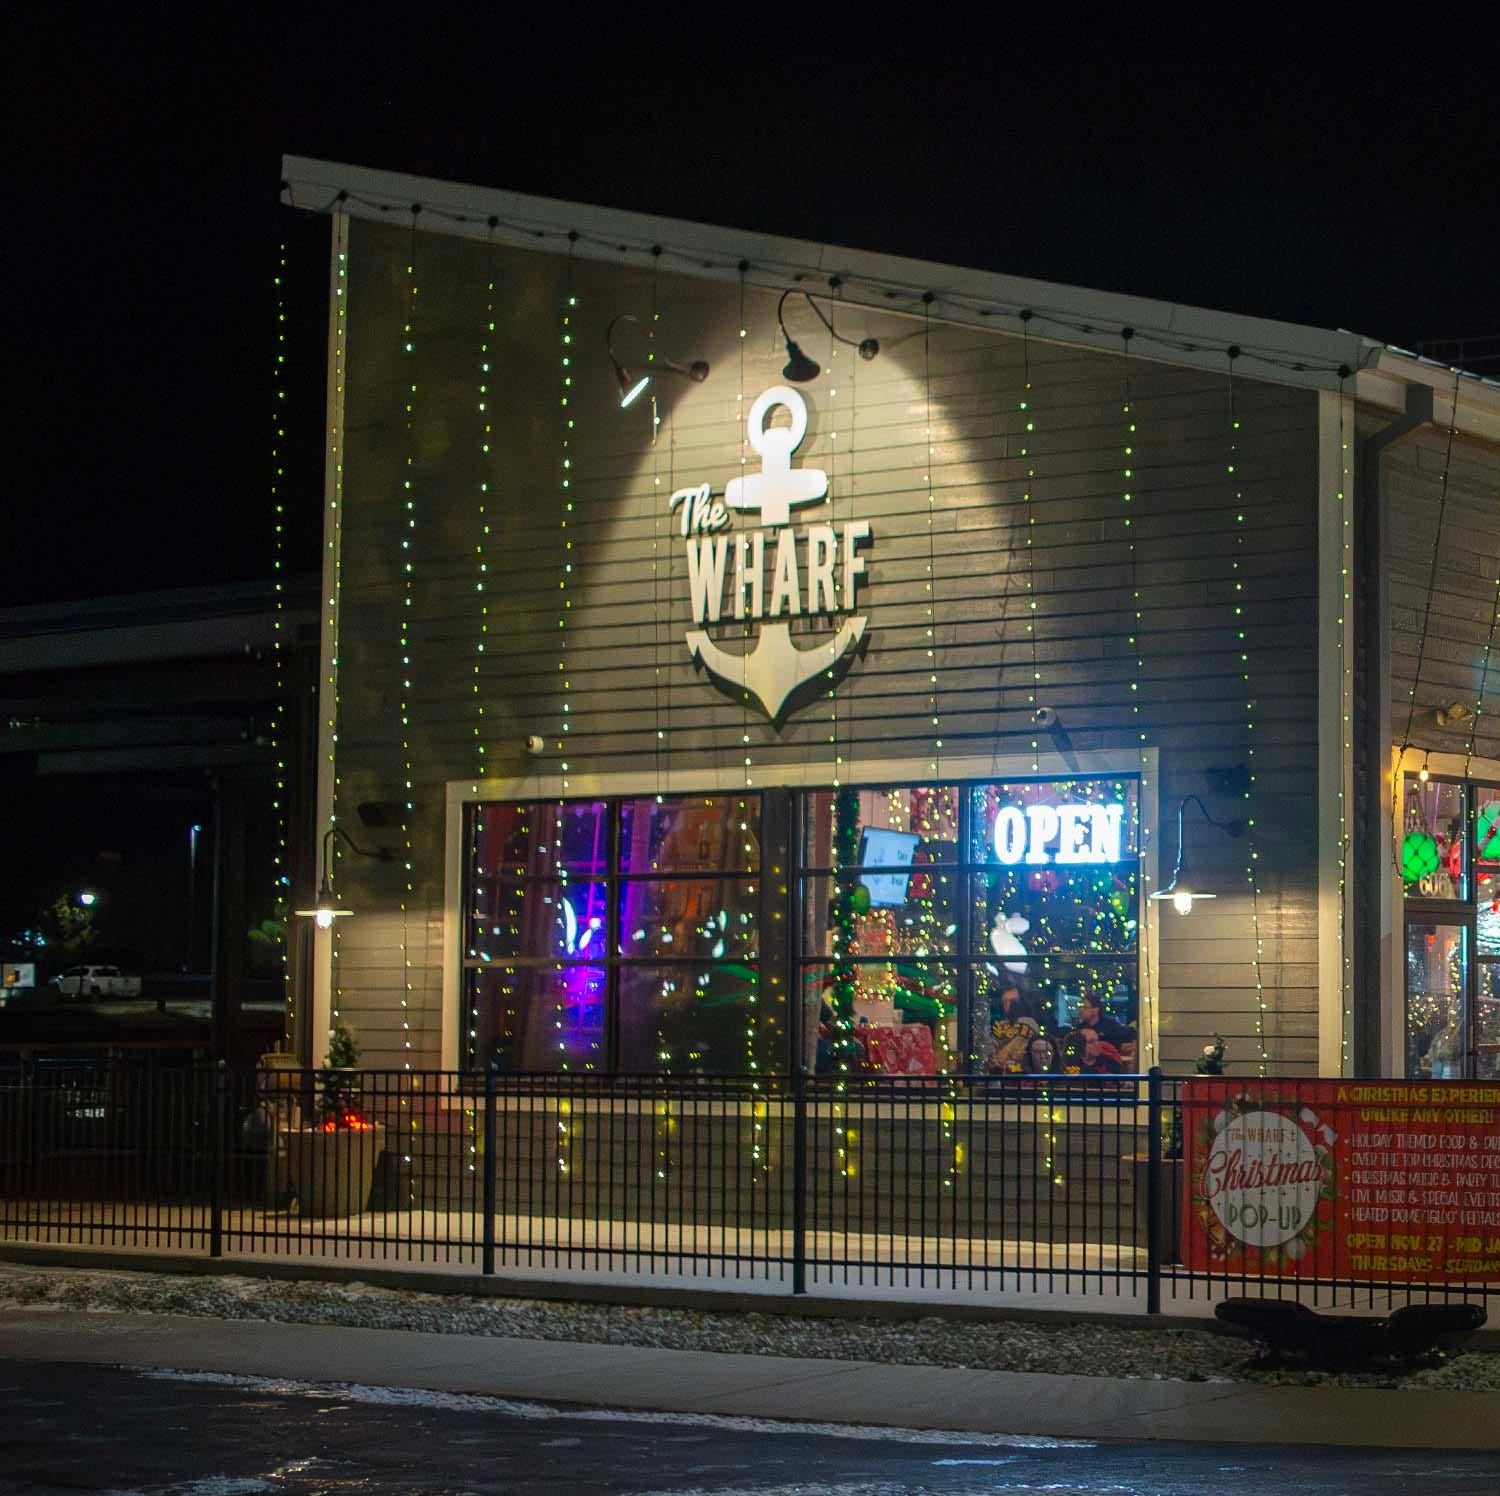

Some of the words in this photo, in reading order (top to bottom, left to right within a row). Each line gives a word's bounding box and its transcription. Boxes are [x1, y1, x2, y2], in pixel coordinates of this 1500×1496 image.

[669, 482, 729, 537] The
[686, 520, 870, 624] WHARF
[994, 805, 1123, 864] OPEN
[1337, 1088, 1347, 1102] A
[1350, 1087, 1428, 1102] CHRISTMAS
[1361, 1108, 1409, 1122] UNLIKE
[1413, 1110, 1440, 1122] ANY
[1443, 1109, 1494, 1124] OTHER!
[1469, 1136, 1478, 1149] &
[1351, 1152, 1377, 1166] OVER
[1203, 1148, 1324, 1199] Christmas
[1352, 1170, 1406, 1185] CHRISTMAS
[1442, 1173, 1449, 1186] &
[1408, 1190, 1416, 1204] &
[1226, 1203, 1301, 1231] POP-UP
[1352, 1207, 1389, 1222] HEATED
[1347, 1234, 1386, 1248] OPEN
[1352, 1256, 1433, 1272] THURSDAYS
